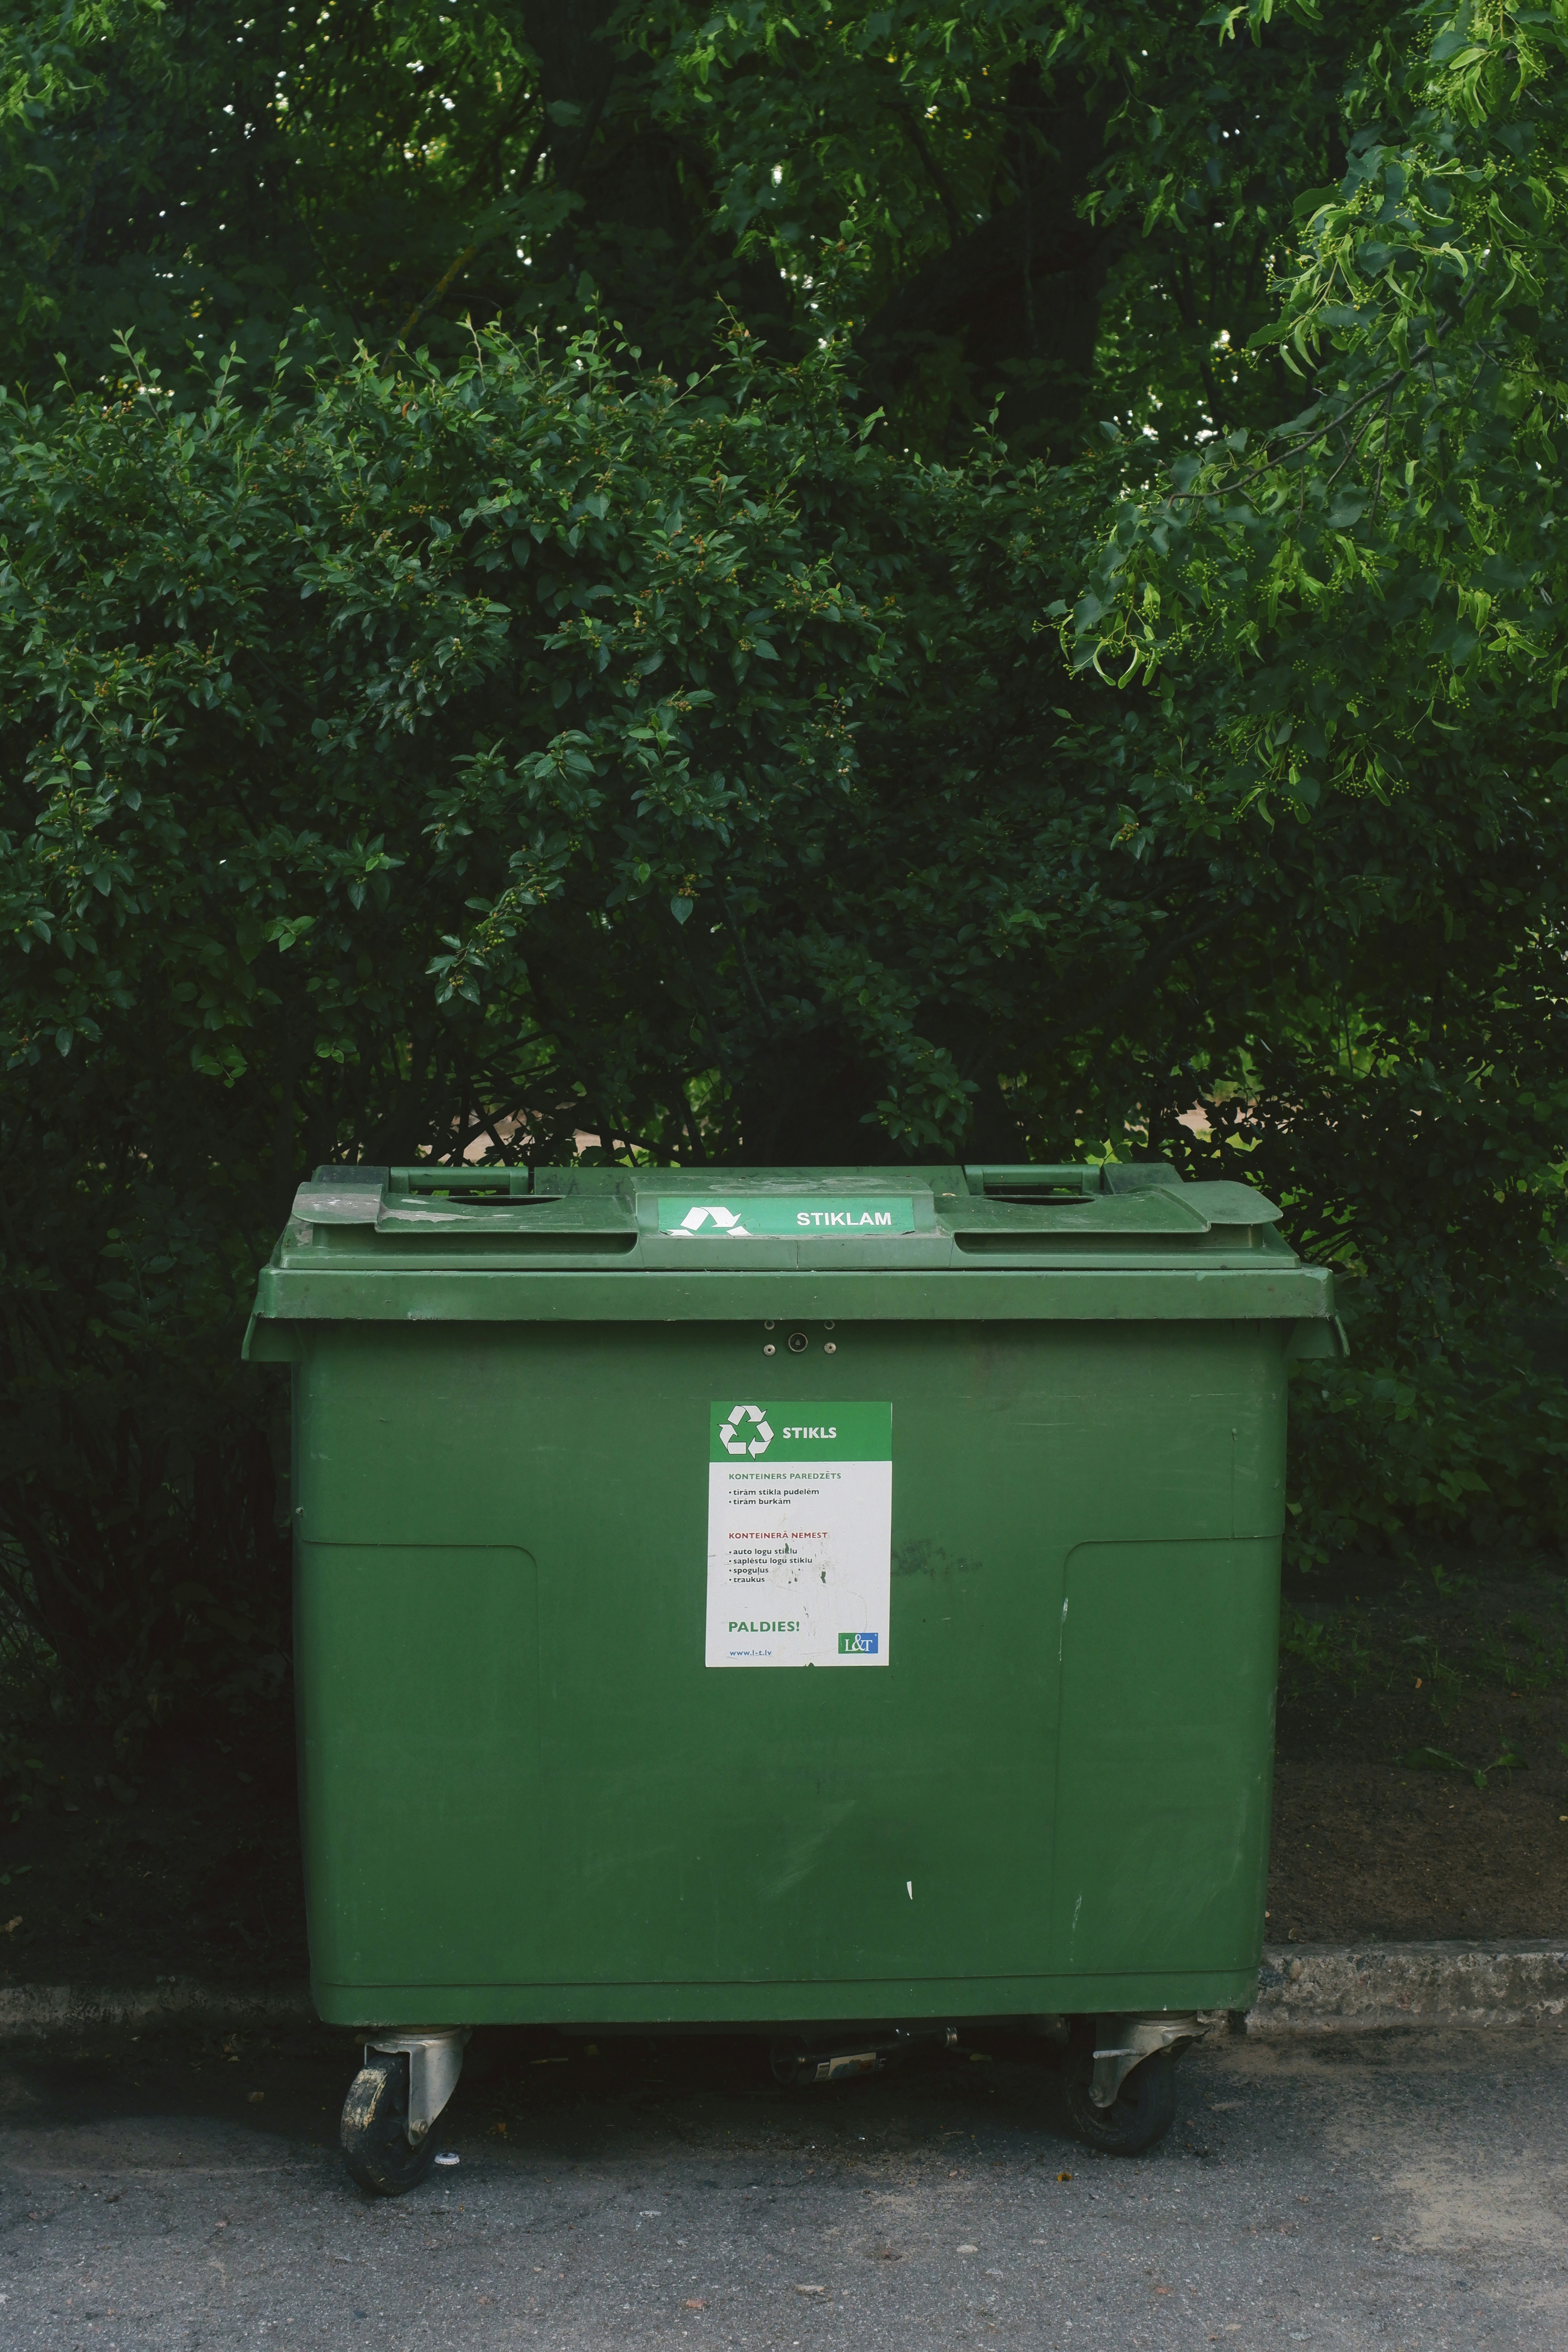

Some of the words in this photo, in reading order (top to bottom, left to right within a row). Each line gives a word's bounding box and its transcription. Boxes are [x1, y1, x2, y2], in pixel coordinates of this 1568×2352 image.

[797, 1212, 892, 1226] STIKLAM
[783, 1427, 837, 1439] STIKLS
[729, 1621, 800, 1632] PALDIES!
[845, 1634, 873, 1651] L&T
